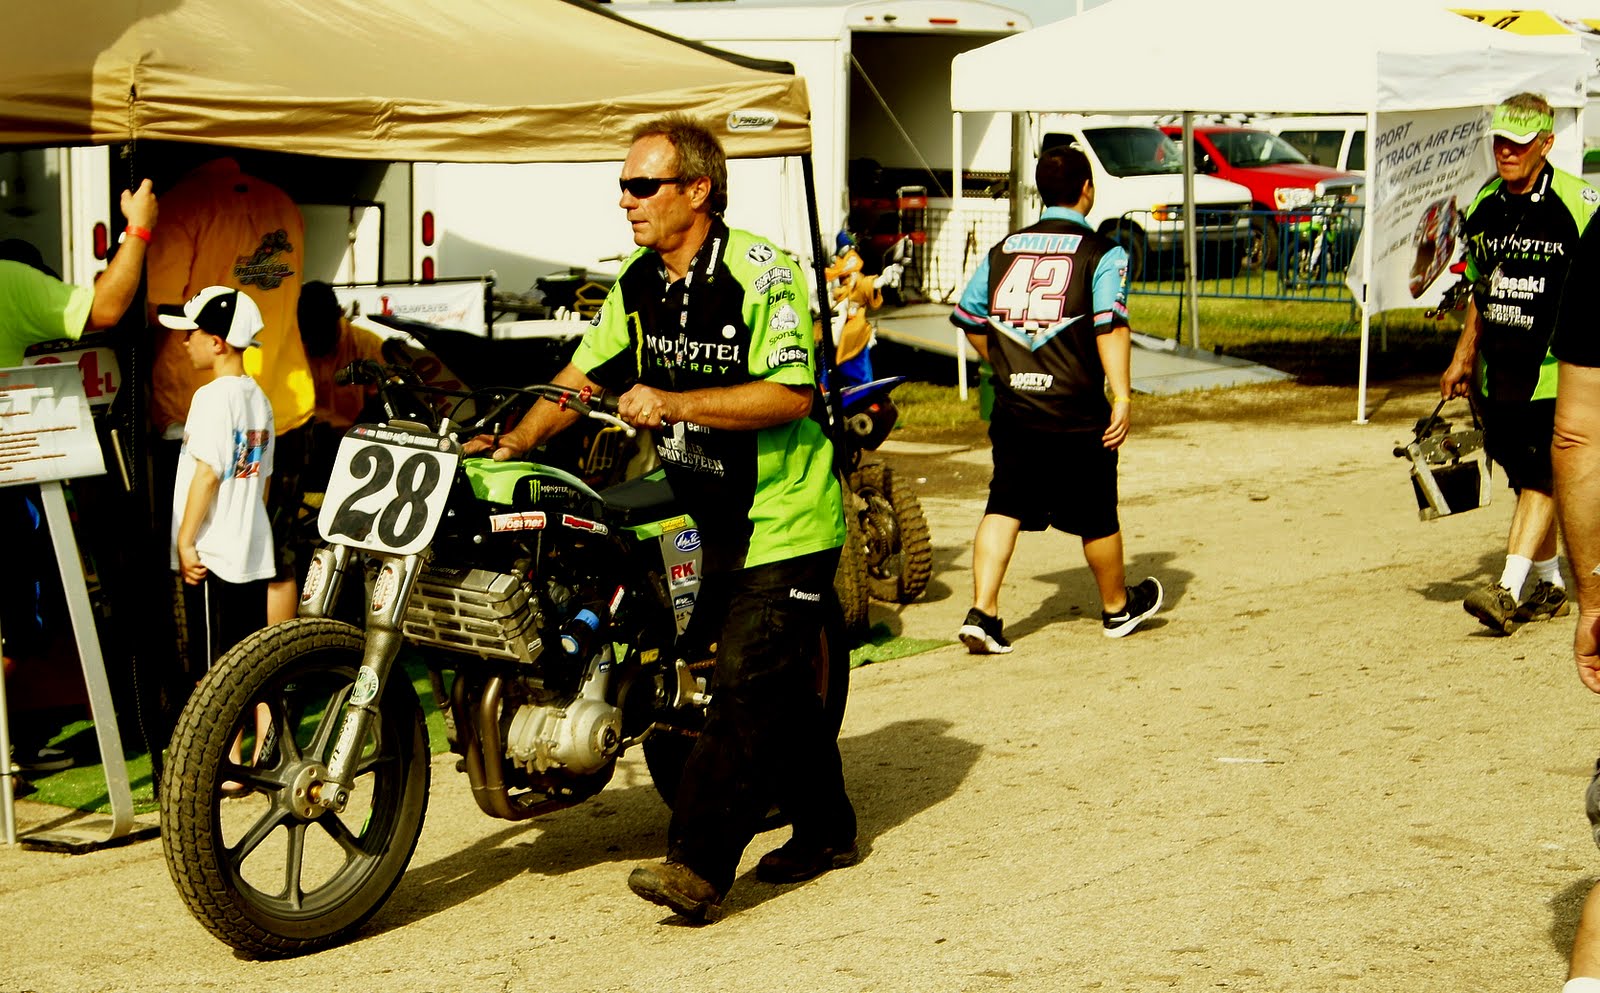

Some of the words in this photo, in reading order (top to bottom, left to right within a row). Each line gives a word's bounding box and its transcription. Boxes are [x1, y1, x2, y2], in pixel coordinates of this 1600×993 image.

[1386, 138, 1425, 169] TRACK
[1424, 128, 1450, 152] AIR
[1003, 233, 1083, 254] SMITH
[992, 255, 1073, 325] 42
[328, 445, 440, 548] 28
[671, 561, 695, 580] RK
